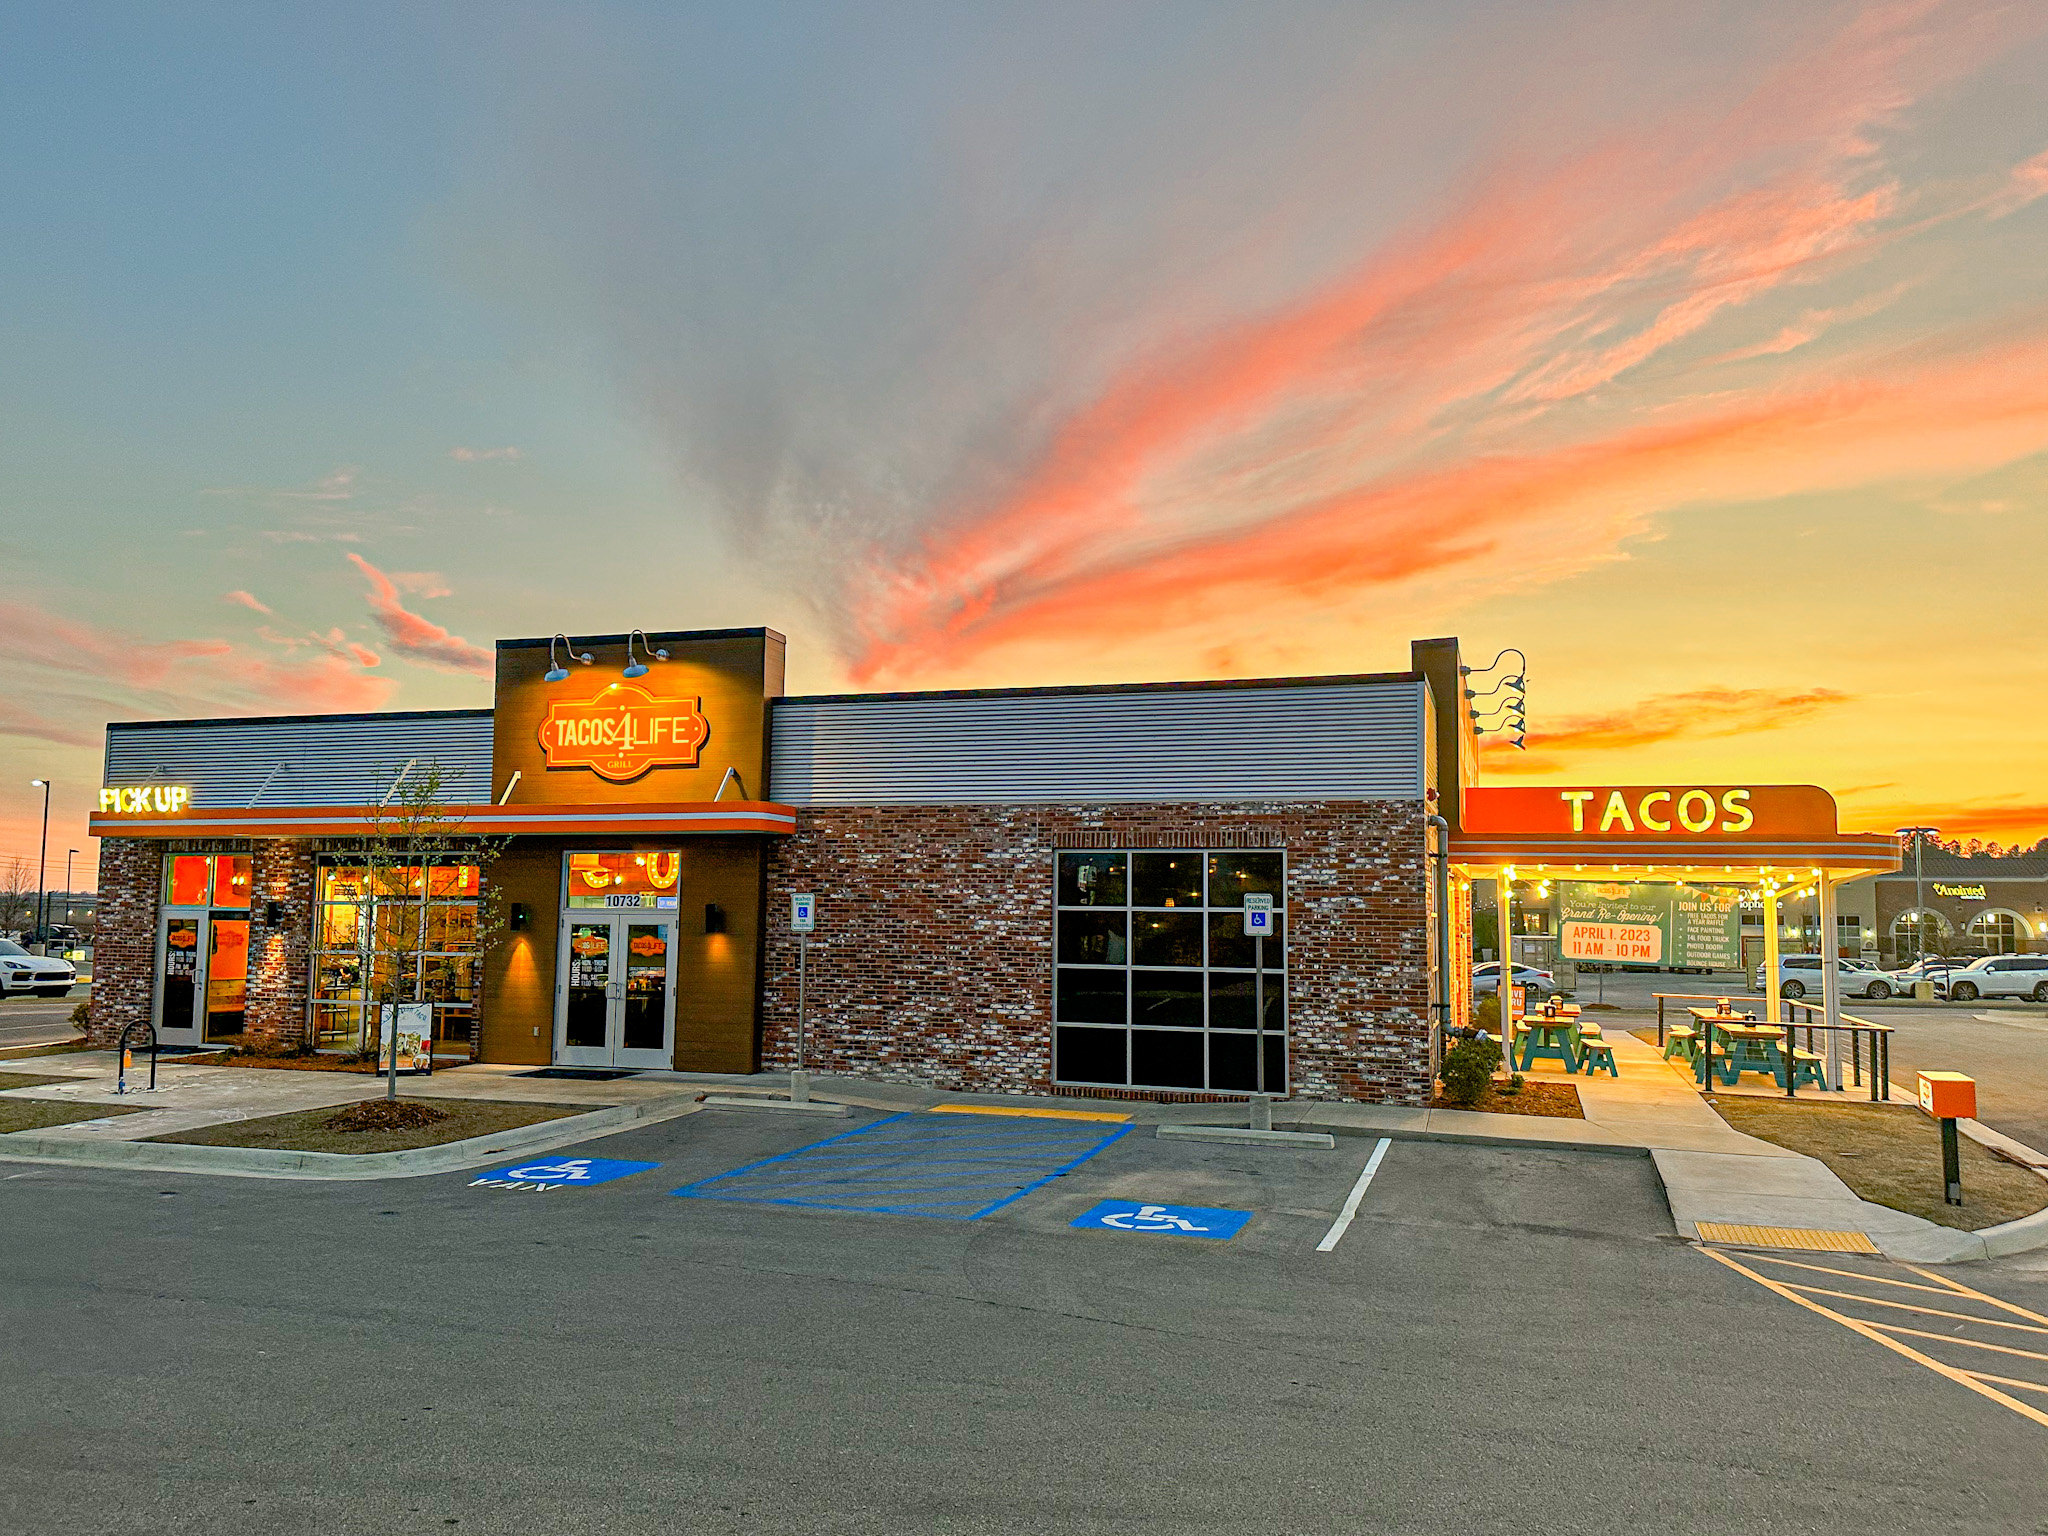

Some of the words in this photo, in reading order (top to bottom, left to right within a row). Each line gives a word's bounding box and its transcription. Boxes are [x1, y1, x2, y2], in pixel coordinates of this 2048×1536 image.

[607, 760, 633, 769] GRILL
[99, 787, 153, 813] PICK
[154, 786, 187, 813] UP
[1561, 789, 1754, 833] TACOS
[1936, 884, 1987, 897] Anointed
[606, 895, 640, 907] 10732
[1569, 900, 1597, 908] You're
[1598, 902, 1629, 910] invited
[1678, 901, 1697, 912] JOIN
[1699, 902, 1712, 912] US
[1714, 902, 1731, 913] FOR
[1561, 906, 1596, 920] Grand
[1597, 908, 1664, 925] Re-Opening!
[1573, 926, 1606, 940] APRIL
[1620, 928, 1650, 942] 2023
[1573, 941, 1581, 954] 11
[1585, 942, 1603, 955] AM
[1616, 943, 1628, 956] 10
[1632, 944, 1650, 957] PM
[1686, 951, 1711, 959] OUTDOOR
